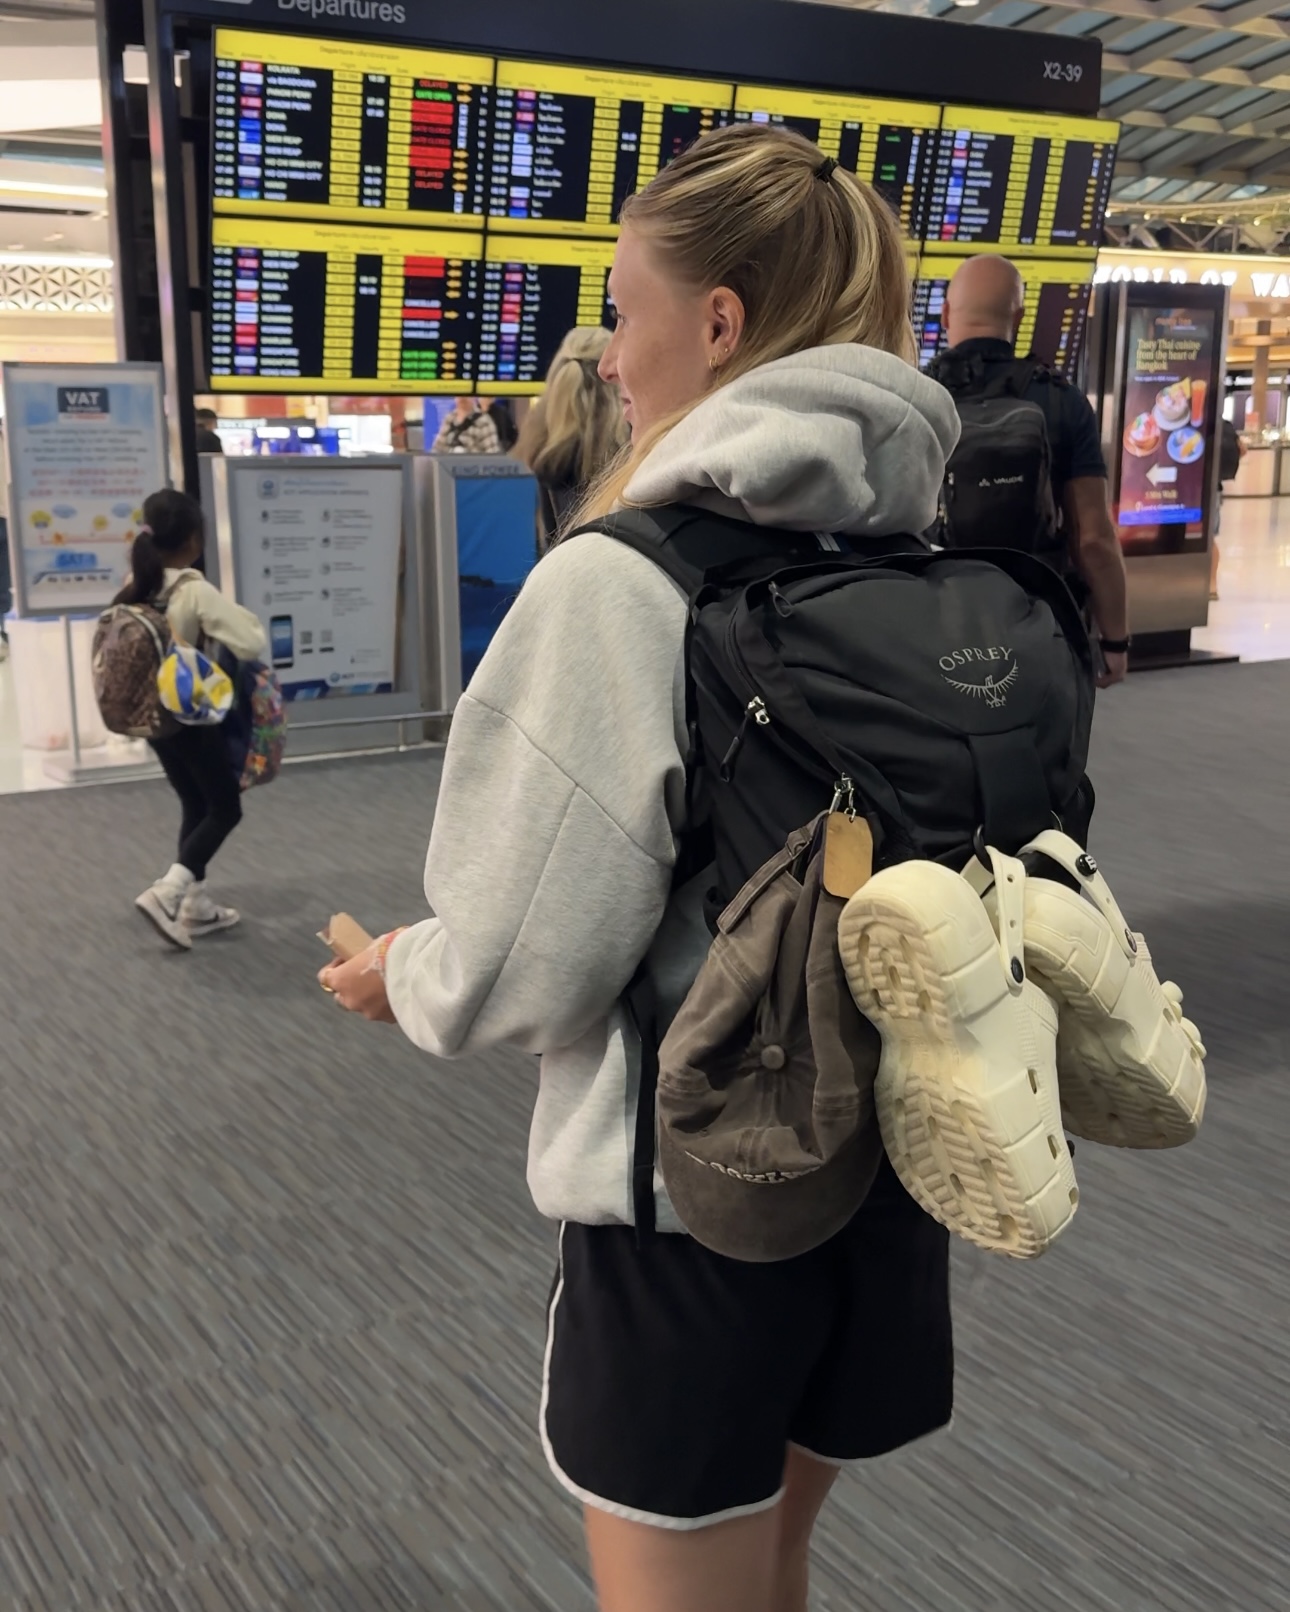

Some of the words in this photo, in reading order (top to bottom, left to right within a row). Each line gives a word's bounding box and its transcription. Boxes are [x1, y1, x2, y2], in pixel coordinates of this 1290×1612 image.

[1043, 60, 1082, 82] X2-39
[1250, 272, 1290, 298] WA
[1137, 338, 1157, 350] Tasty
[1157, 338, 1174, 350] Thai
[1174, 339, 1201, 351] cuisine
[1136, 349, 1154, 360] from
[1155, 350, 1167, 360] the
[1168, 350, 1186, 361] heart
[1187, 350, 1198, 361] of
[1136, 360, 1168, 373] Bangkok
[65, 391, 101, 405] VAT
[939, 646, 1013, 671] OSPREY
